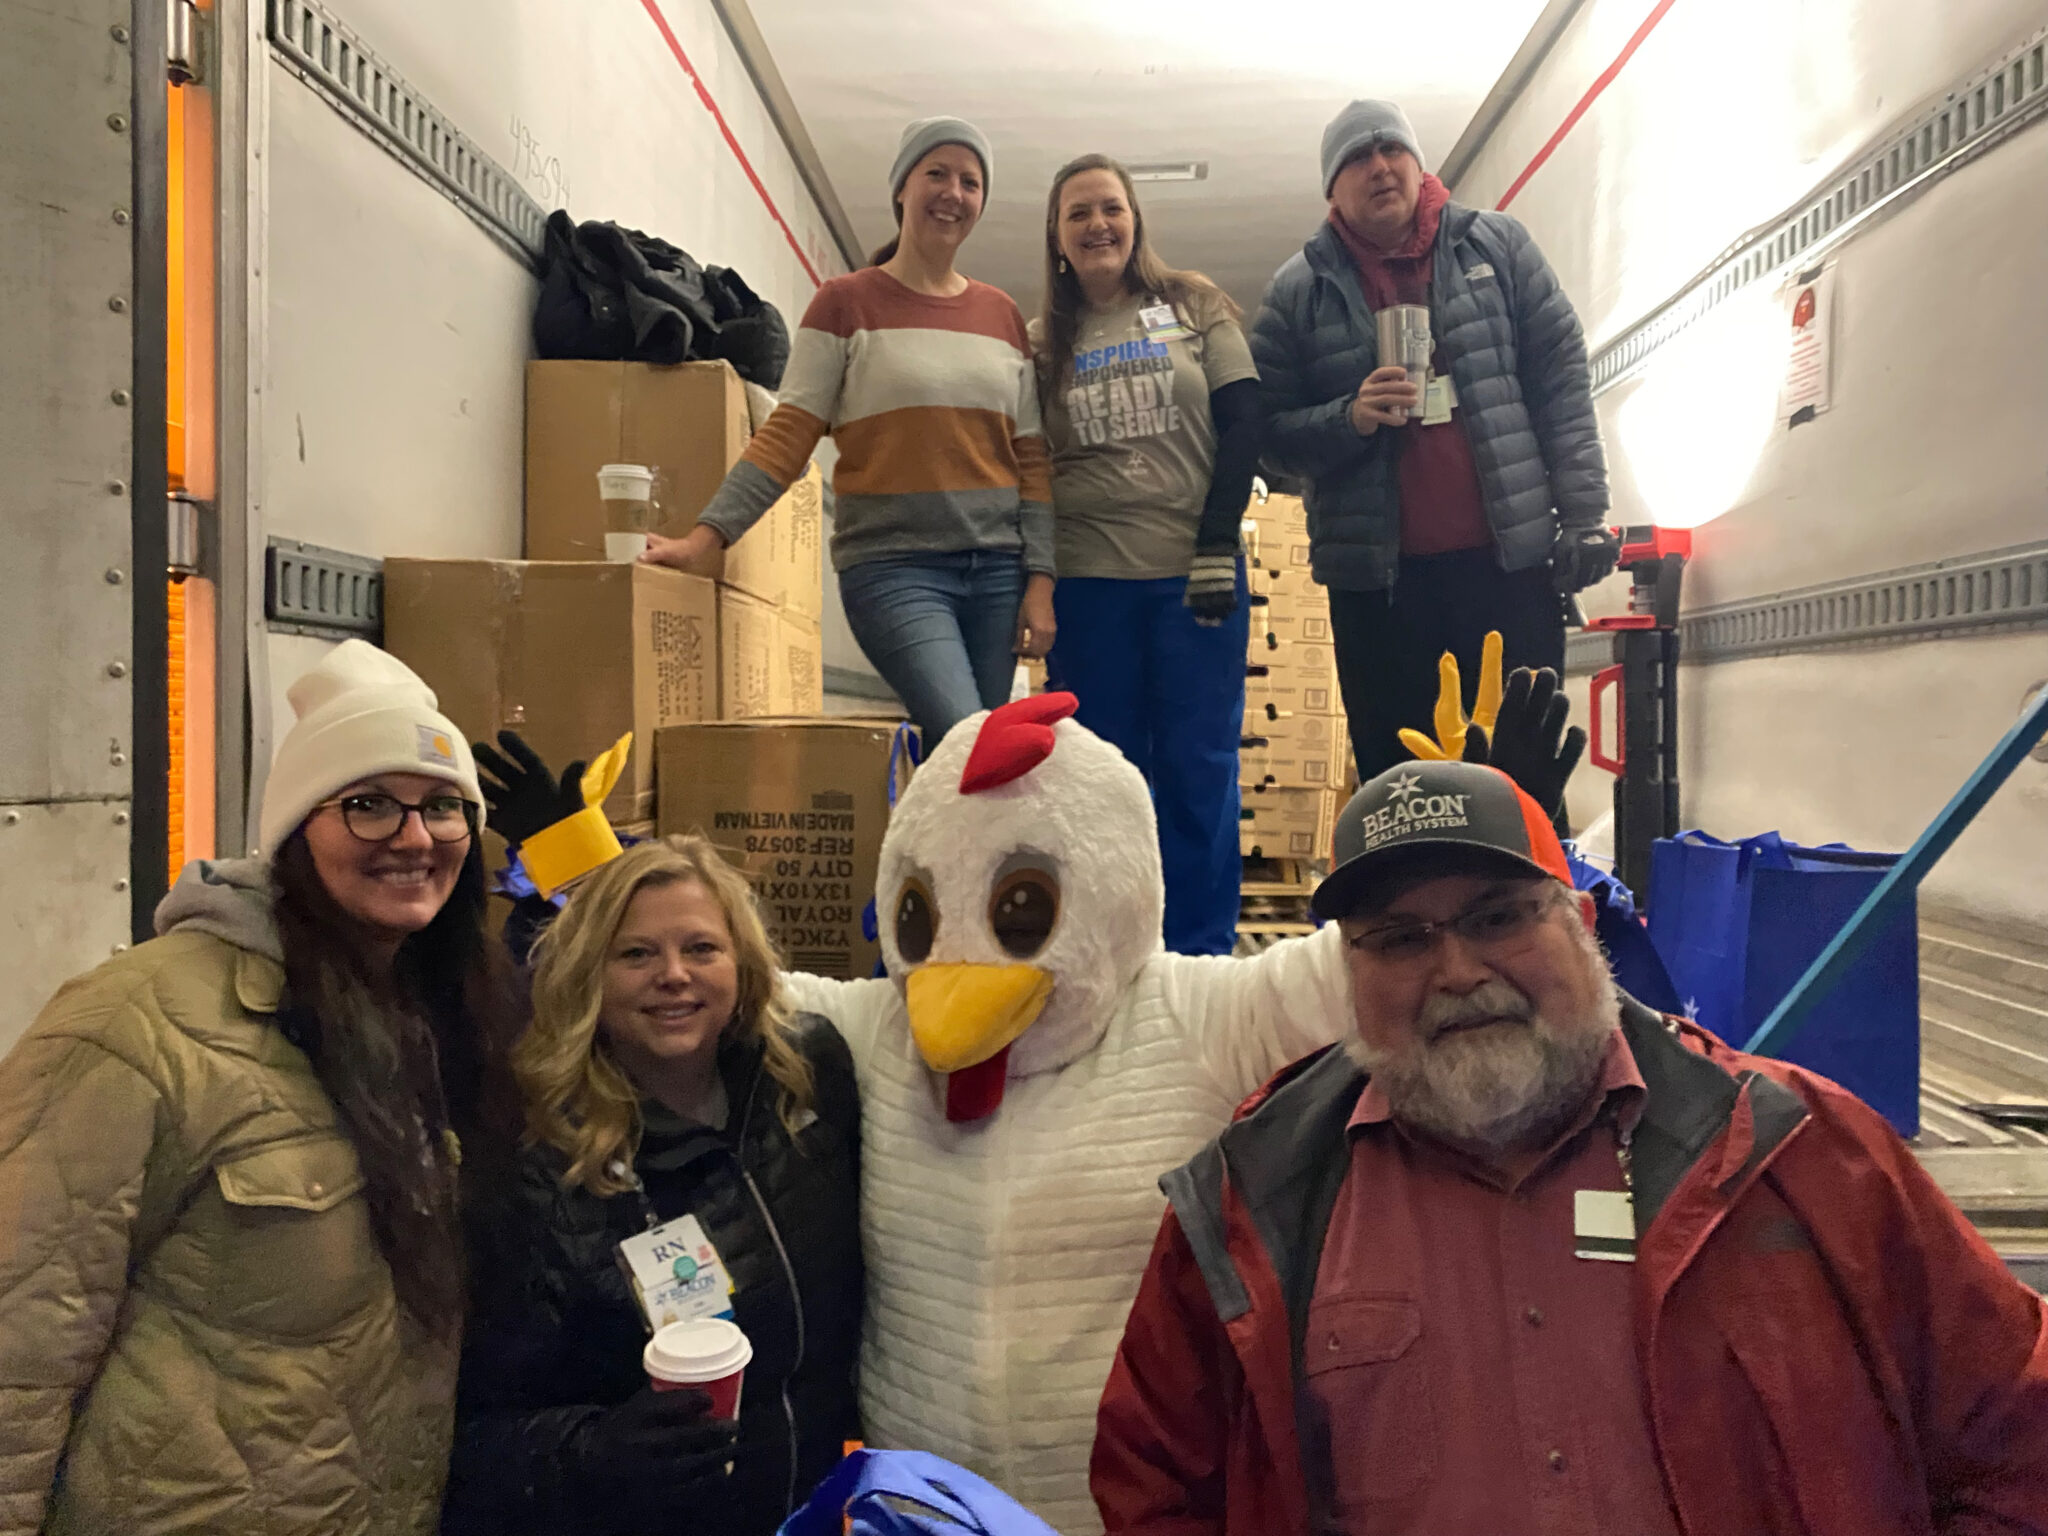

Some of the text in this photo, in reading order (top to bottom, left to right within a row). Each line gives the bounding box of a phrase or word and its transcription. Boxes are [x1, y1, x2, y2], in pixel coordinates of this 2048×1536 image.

[1075, 337, 1168, 373] NSPIRED
[1067, 370, 1175, 422] READY
[1072, 405, 1180, 446] TO SERVE
[714, 812, 787, 829] VIETNAM
[1363, 794, 1465, 838] BEACON
[746, 836, 854, 855] REF 30578
[1366, 816, 1468, 850] HEALTH SYSTEM
[776, 860, 853, 878] QTY 50
[775, 905, 852, 923] ROYAL
[652, 1236, 686, 1263] RN
